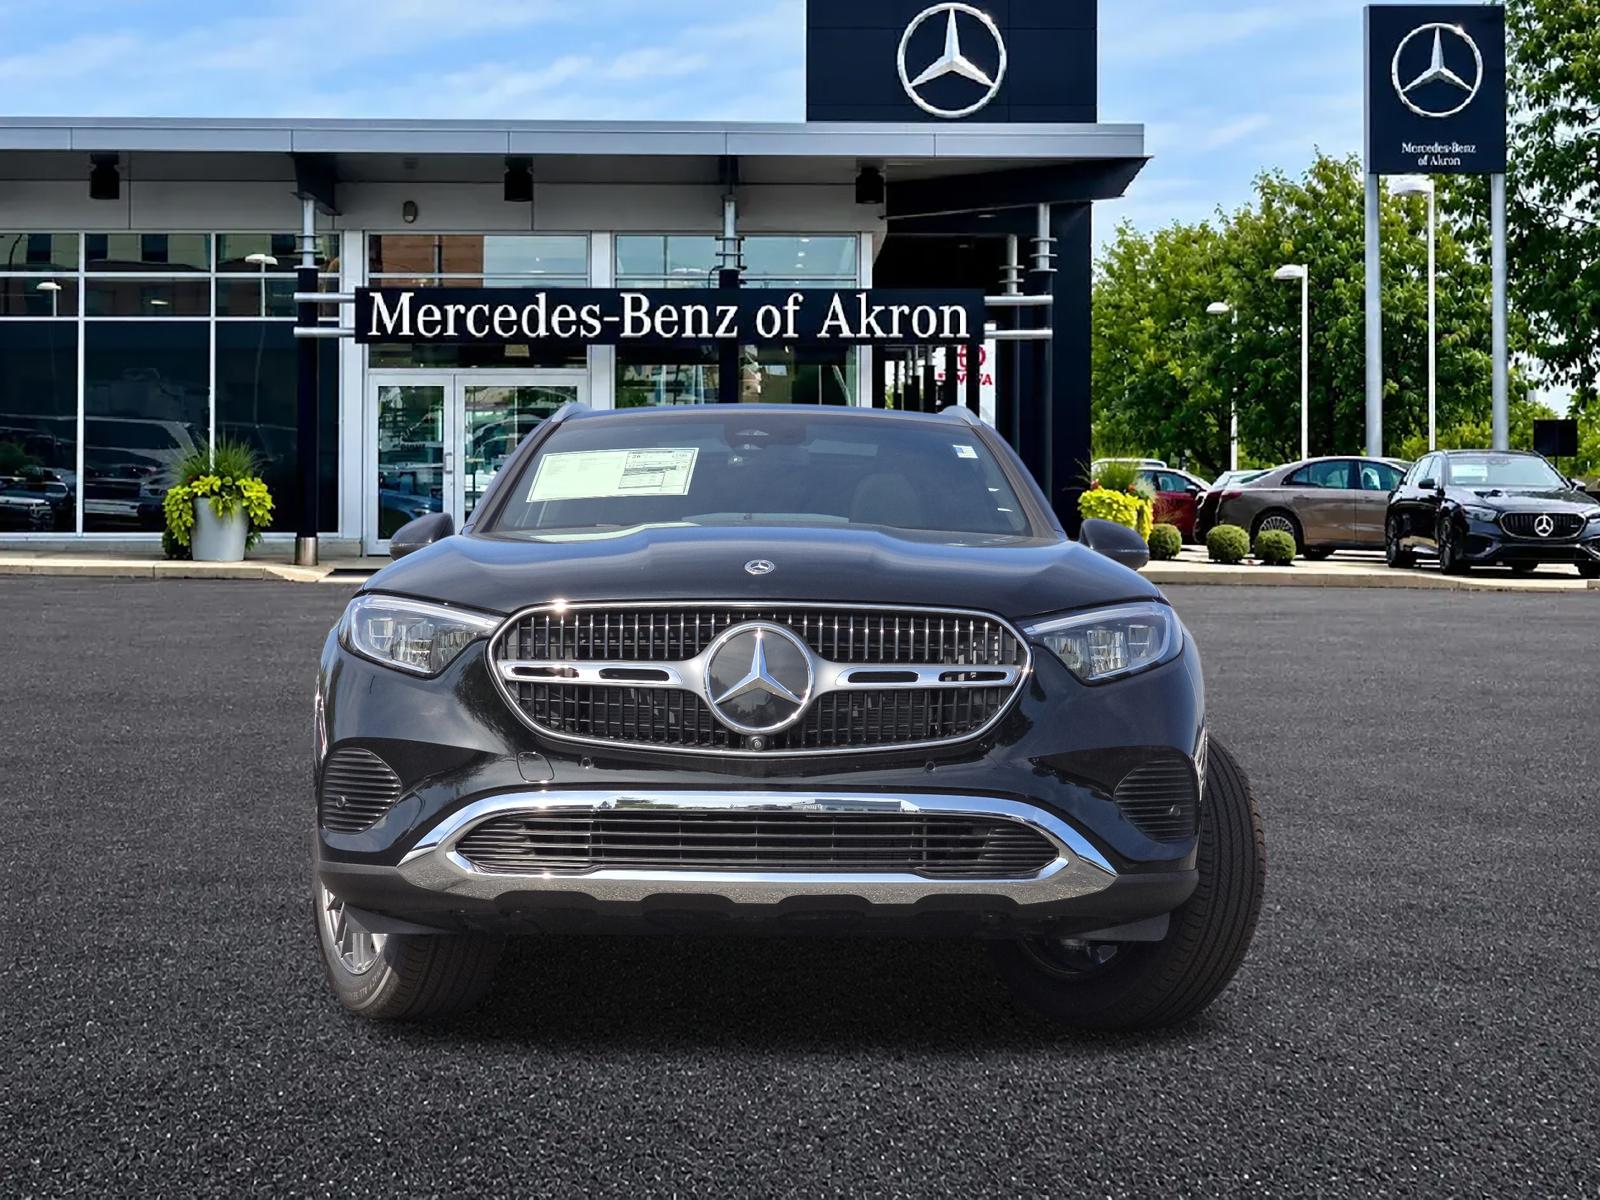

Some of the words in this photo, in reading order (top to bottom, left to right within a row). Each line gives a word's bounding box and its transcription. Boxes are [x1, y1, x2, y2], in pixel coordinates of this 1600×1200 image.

[1401, 141, 1477, 154] Mercedes-Benz
[1417, 154, 1428, 166] of
[1429, 154, 1461, 166] Akron
[367, 291, 738, 338] Mercedes-Benz
[755, 291, 804, 338] of
[816, 291, 971, 338] Akron
